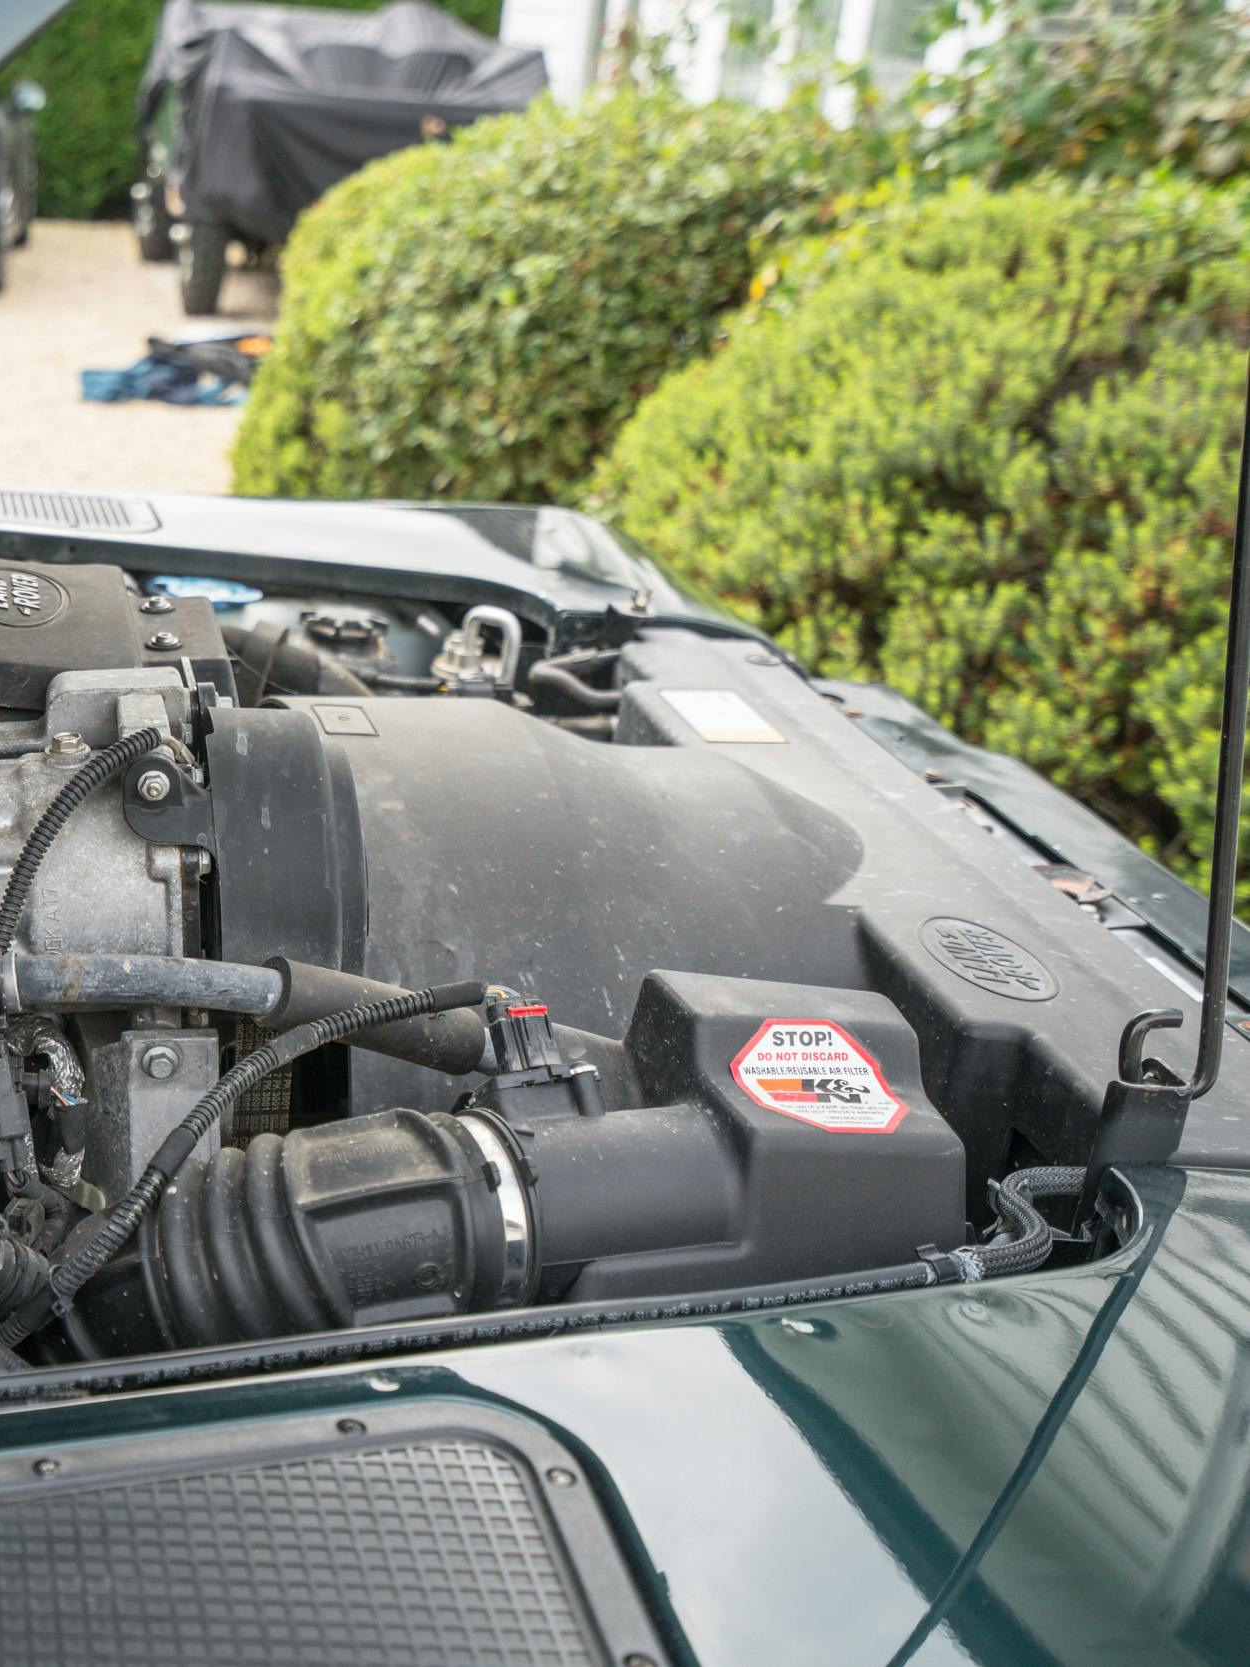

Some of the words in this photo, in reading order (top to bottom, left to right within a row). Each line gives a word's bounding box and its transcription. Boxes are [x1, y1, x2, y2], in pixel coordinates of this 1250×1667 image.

[772, 1031, 833, 1047] STOP!
[758, 1052, 772, 1061] DO
[776, 1052, 798, 1061] NOT
[801, 1052, 849, 1062] DISCARD
[743, 1066, 828, 1076] WASHABLE/REUSABLE
[829, 1067, 842, 1076] AIR
[843, 1067, 870, 1076] FILTER
[802, 1078, 871, 1104] K&N
